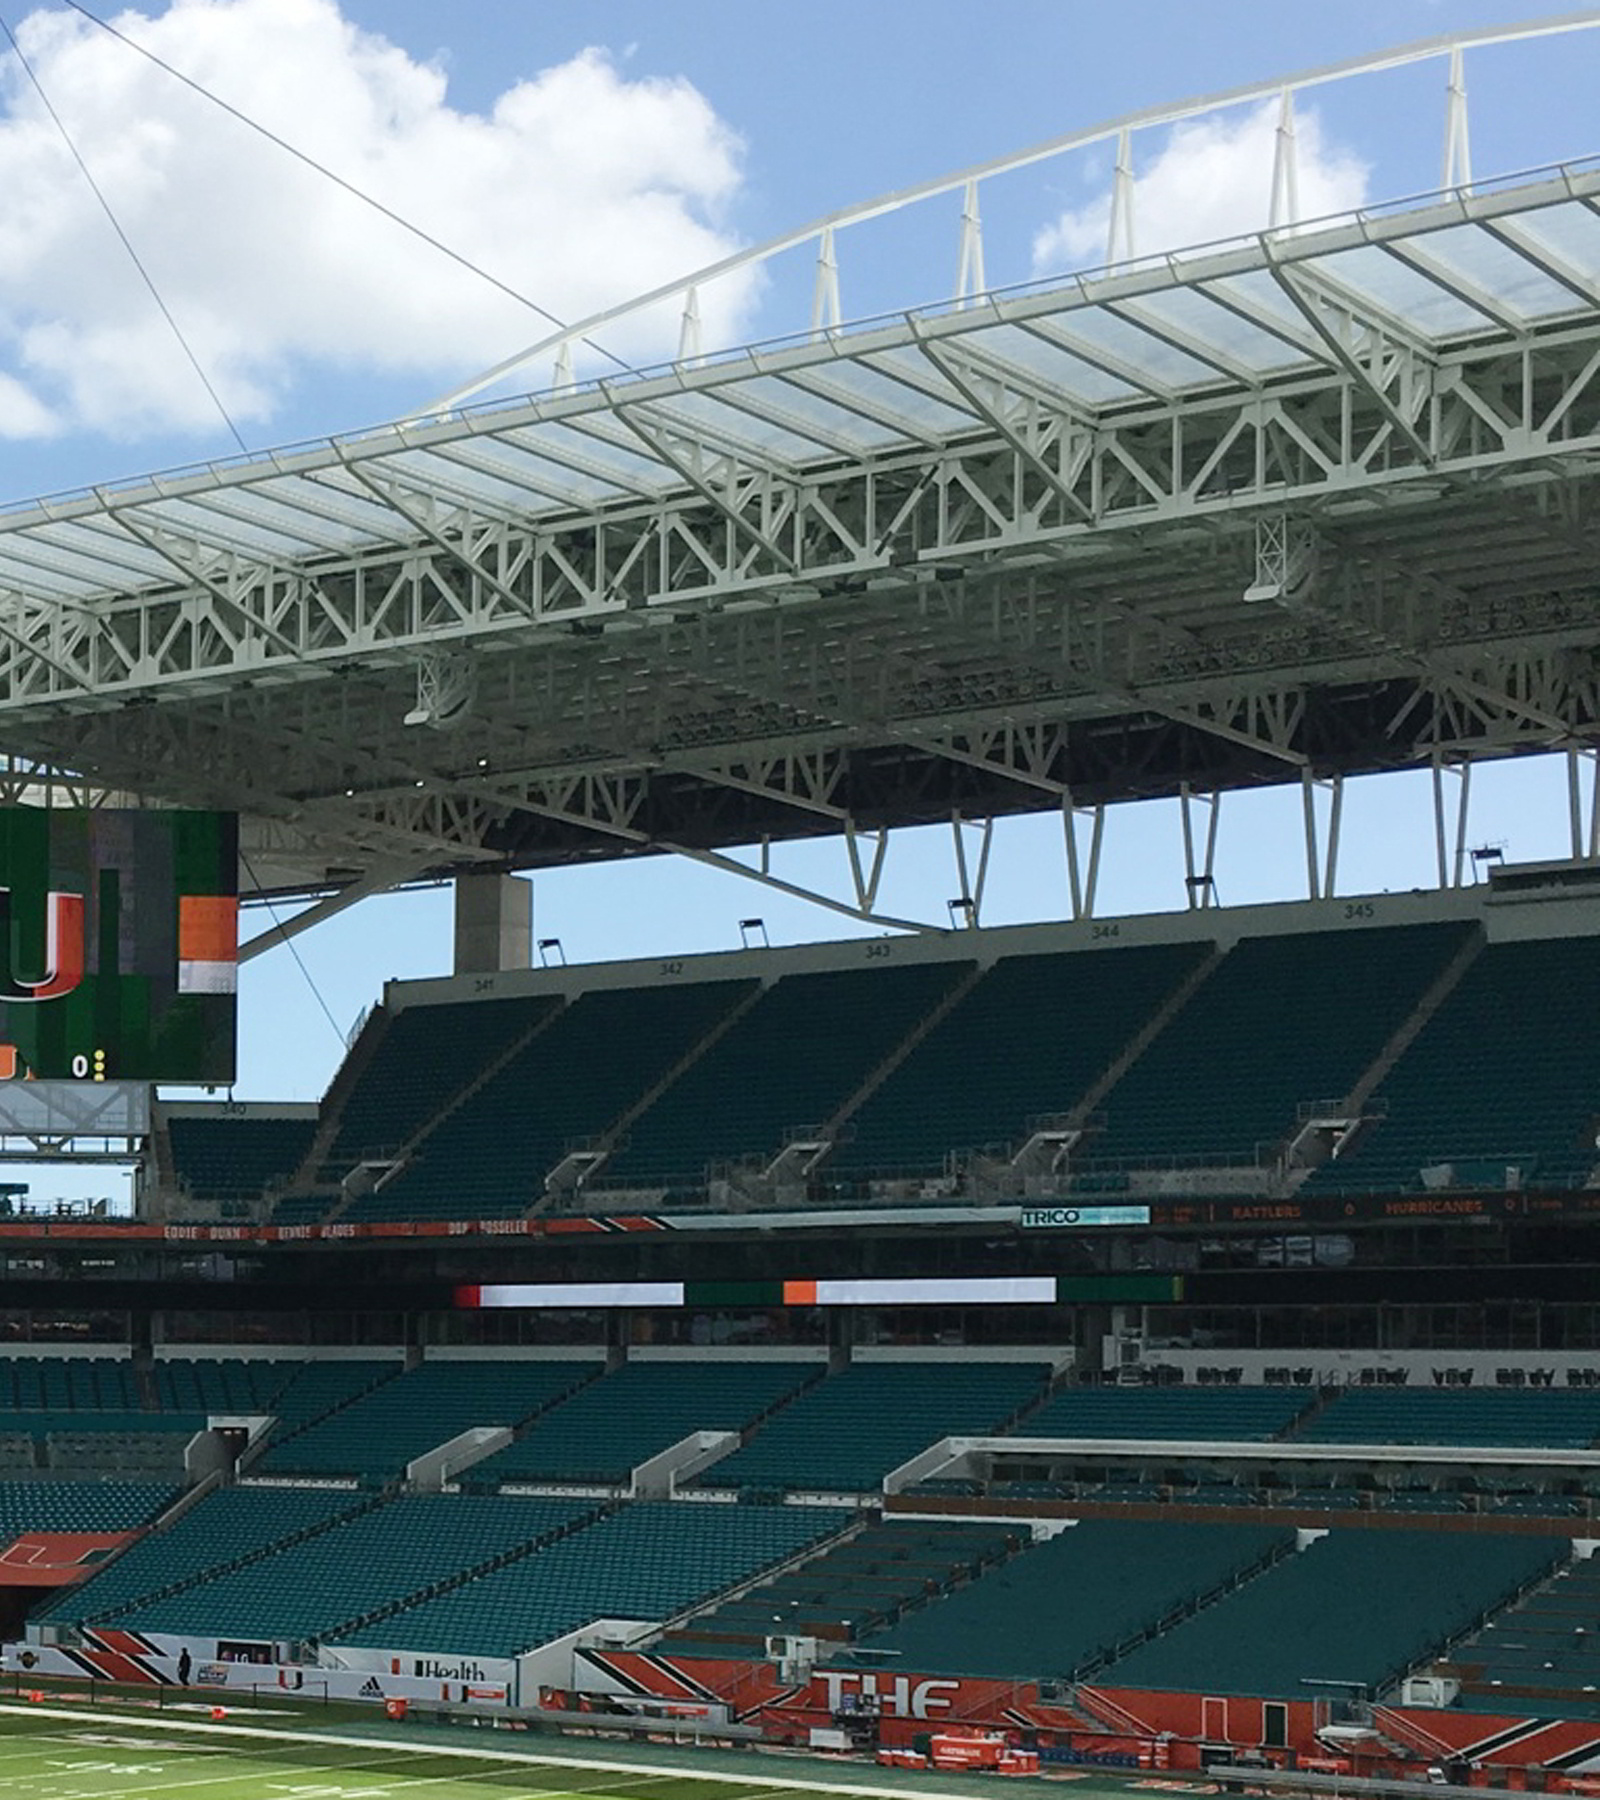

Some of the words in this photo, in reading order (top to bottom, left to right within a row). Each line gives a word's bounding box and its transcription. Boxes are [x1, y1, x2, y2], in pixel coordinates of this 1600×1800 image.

[1344, 903, 1374, 919] 345
[1092, 924, 1119, 940] 344
[865, 945, 890, 959] 343
[72, 1054, 89, 1079] 0
[1022, 1209, 1081, 1226] TRICO
[1232, 1205, 1301, 1219] RATTLERS
[1385, 1201, 1483, 1217] HURRICANES
[163, 1226, 198, 1239] EDDIE
[425, 1659, 486, 1682] Health
